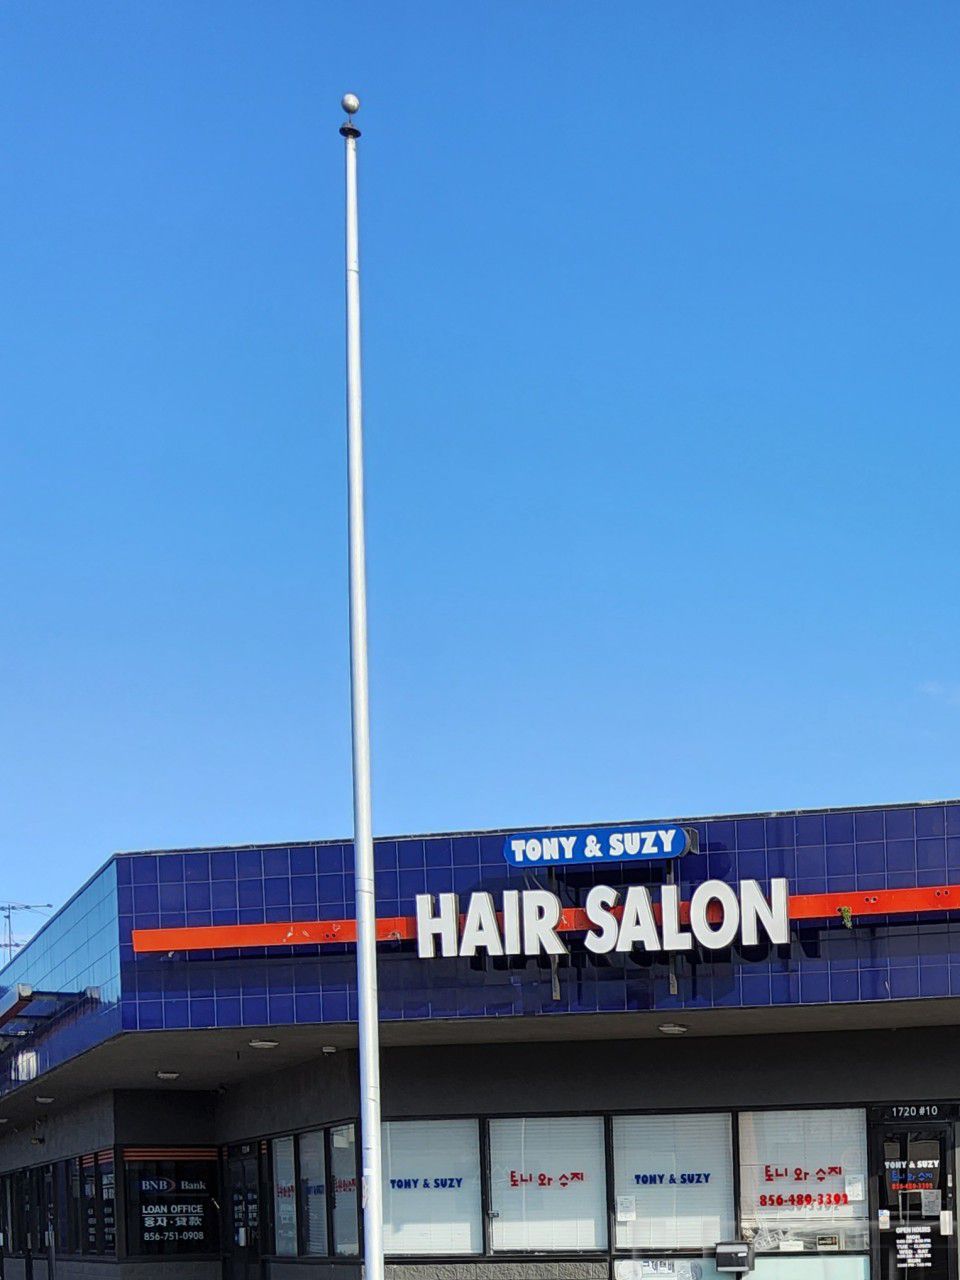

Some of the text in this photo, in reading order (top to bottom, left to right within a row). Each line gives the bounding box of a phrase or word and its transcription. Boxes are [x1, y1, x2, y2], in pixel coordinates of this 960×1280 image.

[511, 830, 677, 862] TONY & SUZY
[415, 877, 790, 958] HAIR SALON
[892, 1106, 938, 1118] 1720 #10
[885, 1161, 908, 1169] TONY
[917, 1159, 940, 1168] SUZY
[389, 1176, 464, 1189] TONY & SUZY
[634, 1172, 712, 1185] TONY & SUZY
[141, 1180, 207, 1191] BNB Bank
[141, 1204, 204, 1213] LOAN OFFICE
[143, 1231, 205, 1241] 856-751-0908
